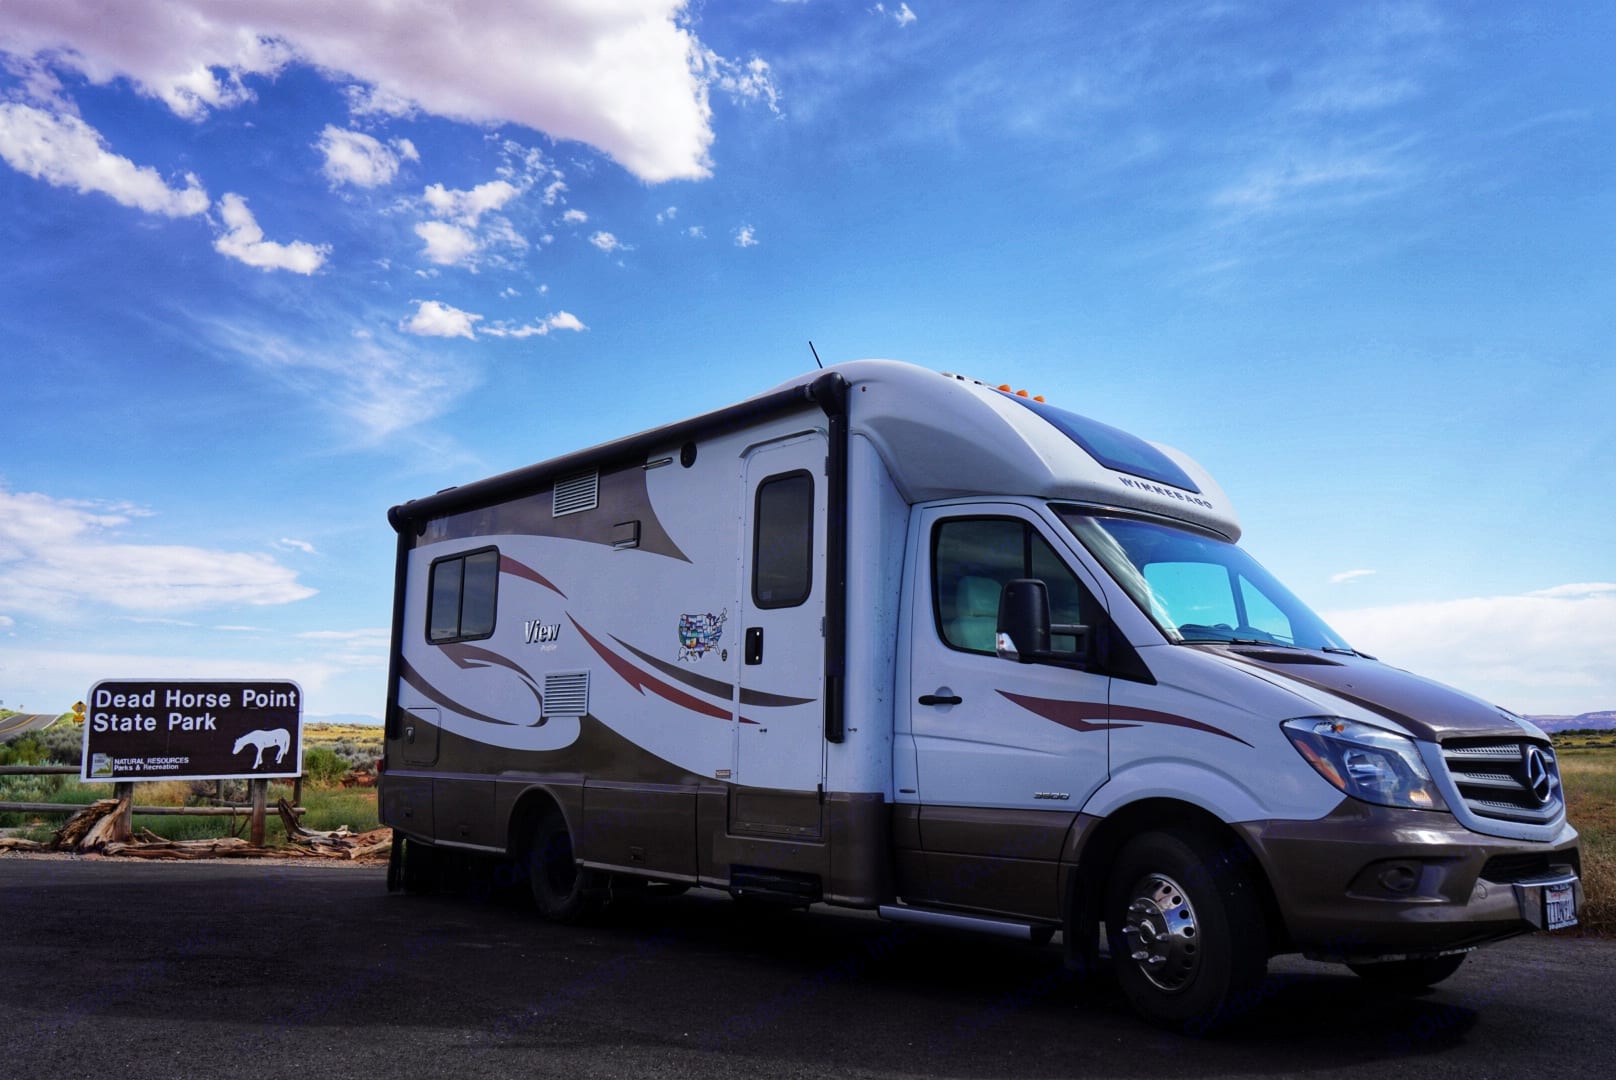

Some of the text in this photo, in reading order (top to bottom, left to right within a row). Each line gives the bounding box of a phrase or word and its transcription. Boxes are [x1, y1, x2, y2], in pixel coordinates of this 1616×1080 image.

[1119, 476, 1213, 510] WINNEBAGO
[524, 619, 561, 644] View
[96, 689, 296, 708] Dead Horse Point
[93, 712, 157, 732] State
[168, 712, 217, 731] Park
